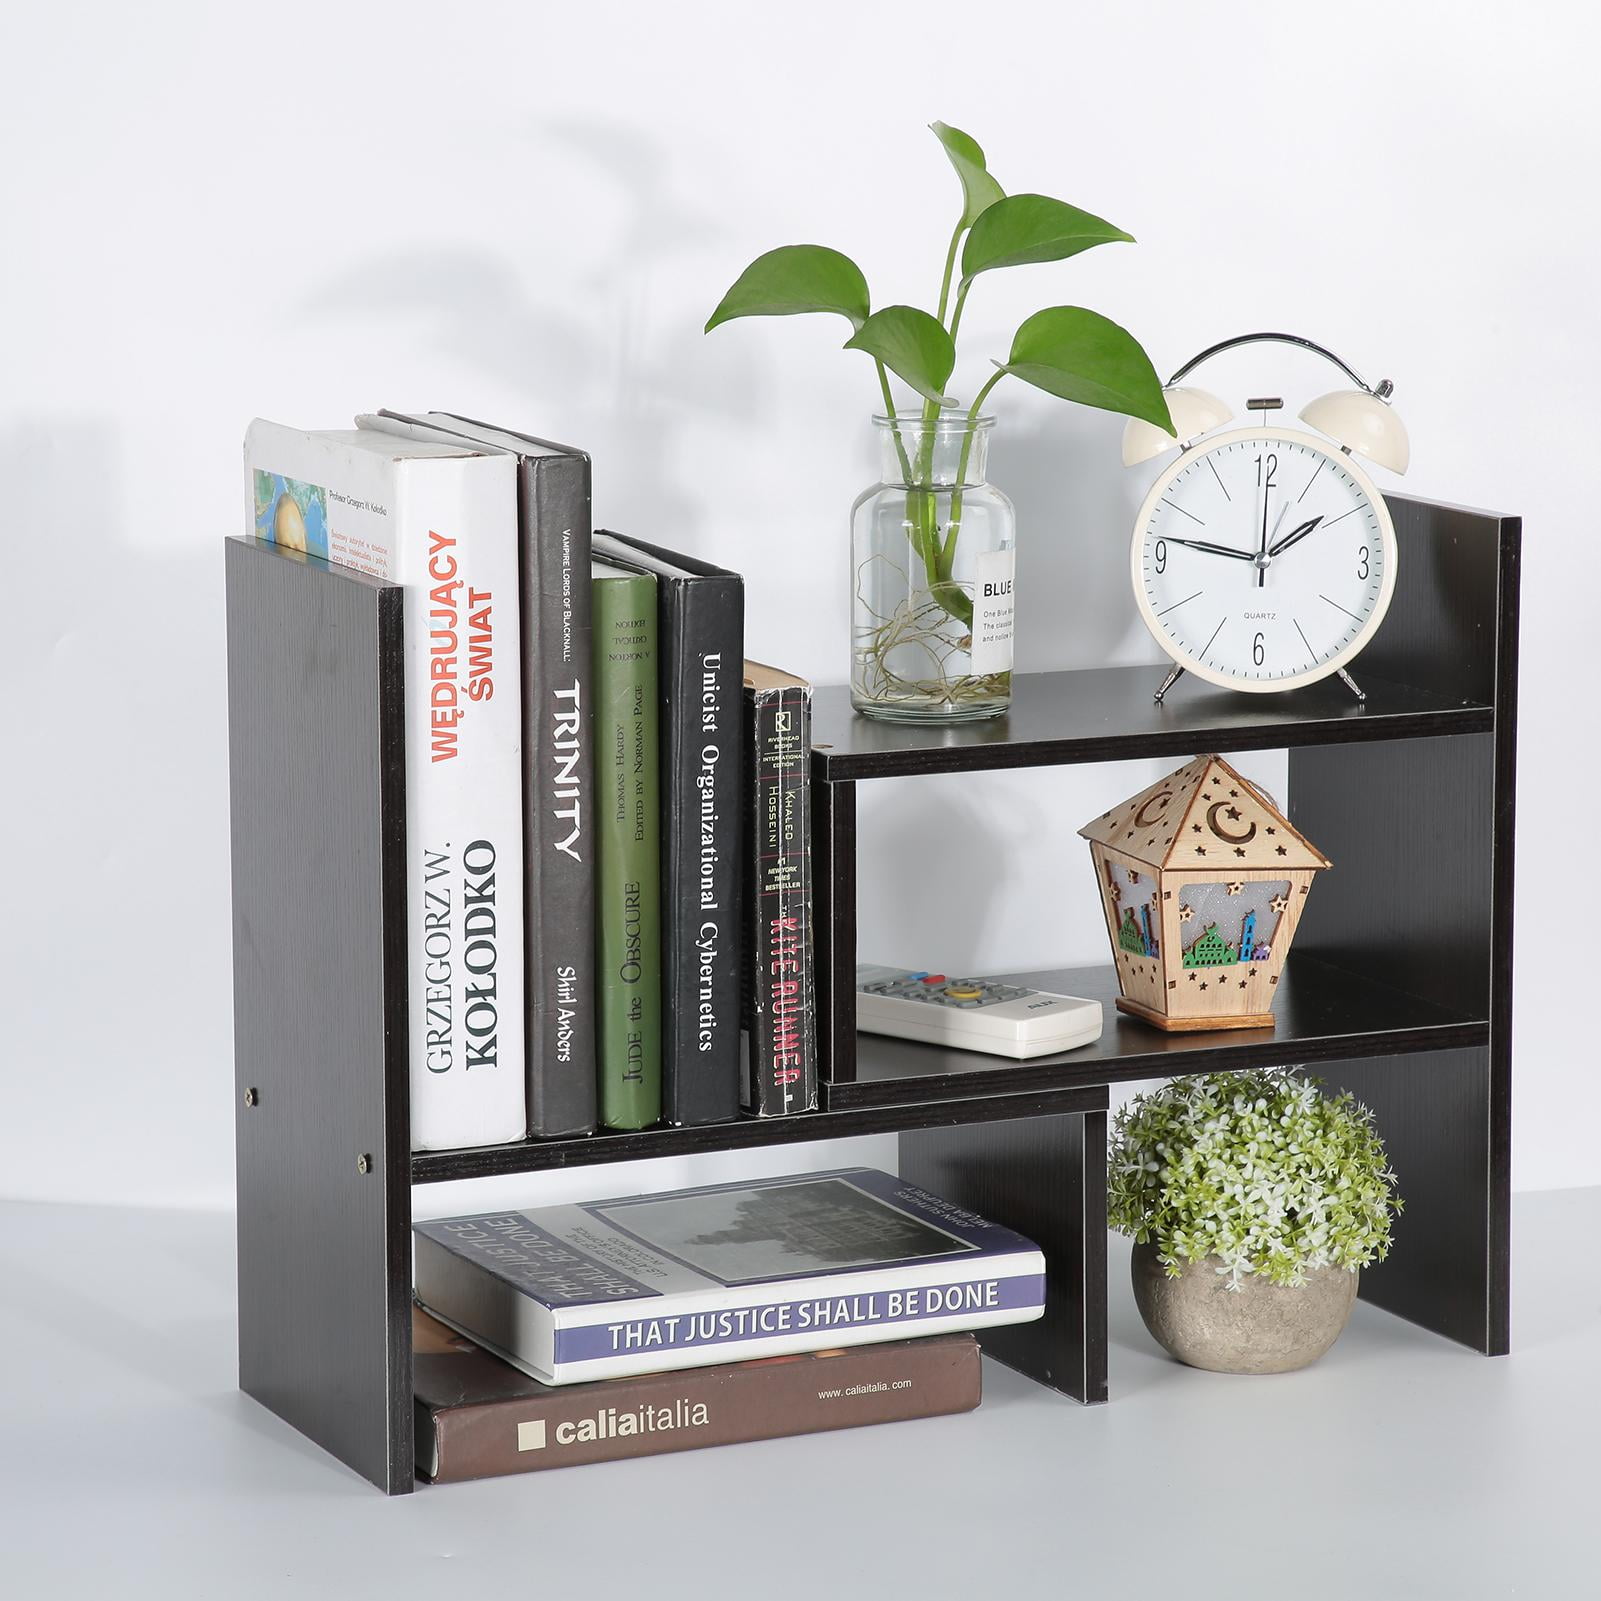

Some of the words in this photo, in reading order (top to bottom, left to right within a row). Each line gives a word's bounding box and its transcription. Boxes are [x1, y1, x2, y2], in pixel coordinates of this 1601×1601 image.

[1254, 454, 1278, 487] 12
[562, 529, 571, 566] VAMPIRE
[1154, 540, 1168, 574] 9
[1357, 546, 1370, 580] 3
[562, 568, 571, 597] LORDS
[562, 598, 571, 609] OF
[984, 581, 1011, 597] BLUE
[983, 610, 996, 618] One
[1243, 612, 1277, 620] QUARTZ
[428, 530, 464, 763] WĘDRUJĄCY
[461, 586, 494, 702] ŚWIAT
[982, 635, 994, 643] and
[1252, 632, 1265, 666] 6
[634, 684, 643, 716] PAGE
[702, 652, 721, 733] Unicist
[616, 724, 625, 766] HARDY
[634, 721, 644, 774] NORMAN
[553, 678, 582, 862] TRINITY
[635, 779, 644, 795] BY
[617, 773, 625, 823] THOMAS
[769, 786, 779, 848] HOSSEINI
[785, 791, 796, 840] KHALED
[635, 800, 644, 842] EDITED
[696, 744, 720, 911] Organizational
[424, 842, 451, 884] W.
[463, 839, 498, 1071] KOŁODKO
[620, 882, 642, 984] OBSCURE
[770, 917, 800, 976] KITE
[424, 888, 453, 1074] GRZEGORZ
[557, 966, 578, 1004] Shirl
[695, 921, 719, 1052] Cybernetics
[627, 997, 642, 1023] the
[557, 1007, 576, 1062] Anders
[771, 980, 801, 1087] RUNNER
[622, 1031, 643, 1083] JUDE
[608, 1319, 680, 1349] THAT
[684, 1305, 792, 1342] JUSTICE
[798, 1294, 881, 1328] SHALL
[888, 1290, 919, 1318] BE
[926, 1281, 999, 1313] DONE
[818, 1390, 844, 1400] www.
[892, 1378, 912, 1390] com
[556, 1399, 709, 1445] caliaitalia
